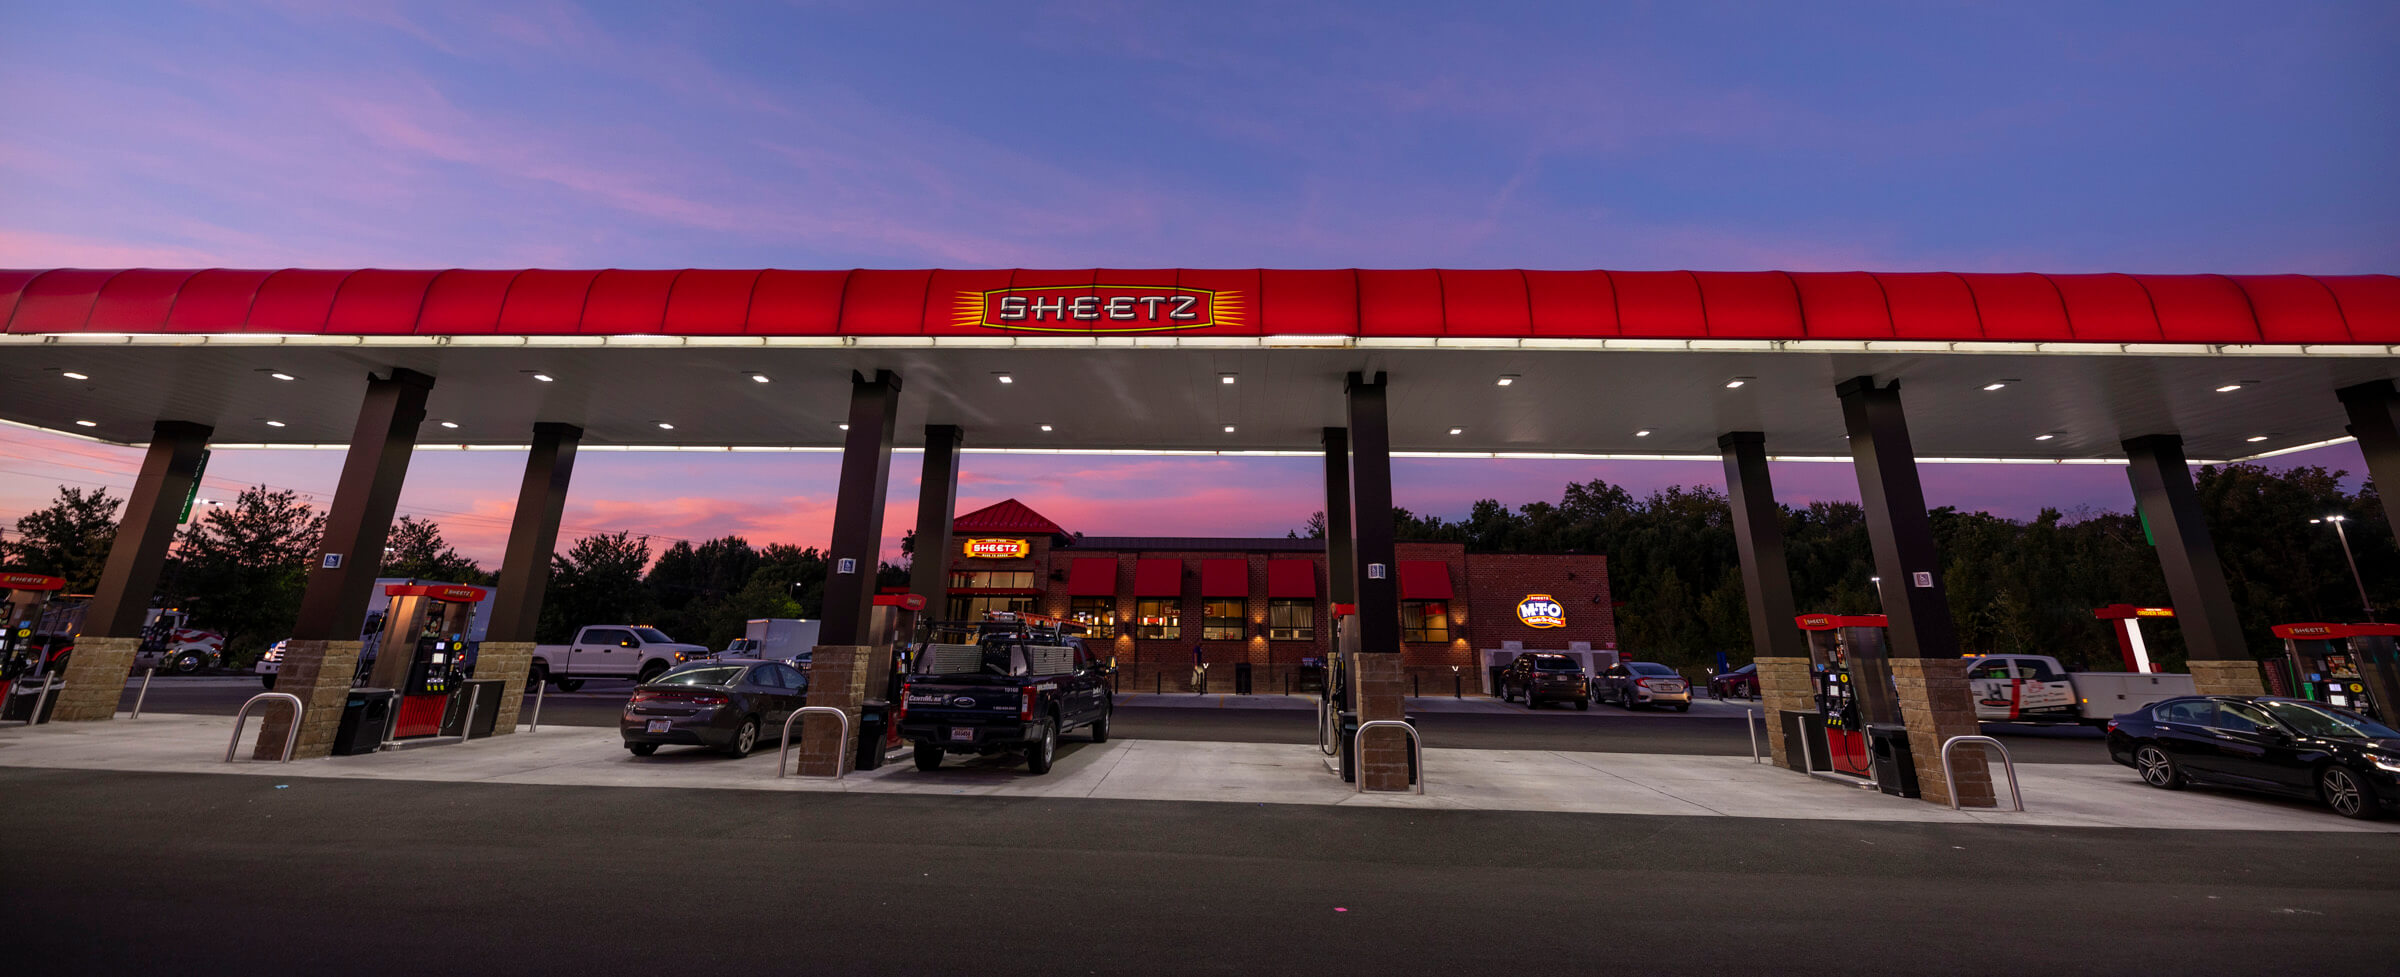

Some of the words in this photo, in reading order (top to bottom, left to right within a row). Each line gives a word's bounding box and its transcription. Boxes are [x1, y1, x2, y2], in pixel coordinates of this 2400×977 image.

[1000, 296, 1197, 321] SHEETZ
[973, 544, 1018, 552] SHEETZ
[11, 576, 42, 584] SHEETZ
